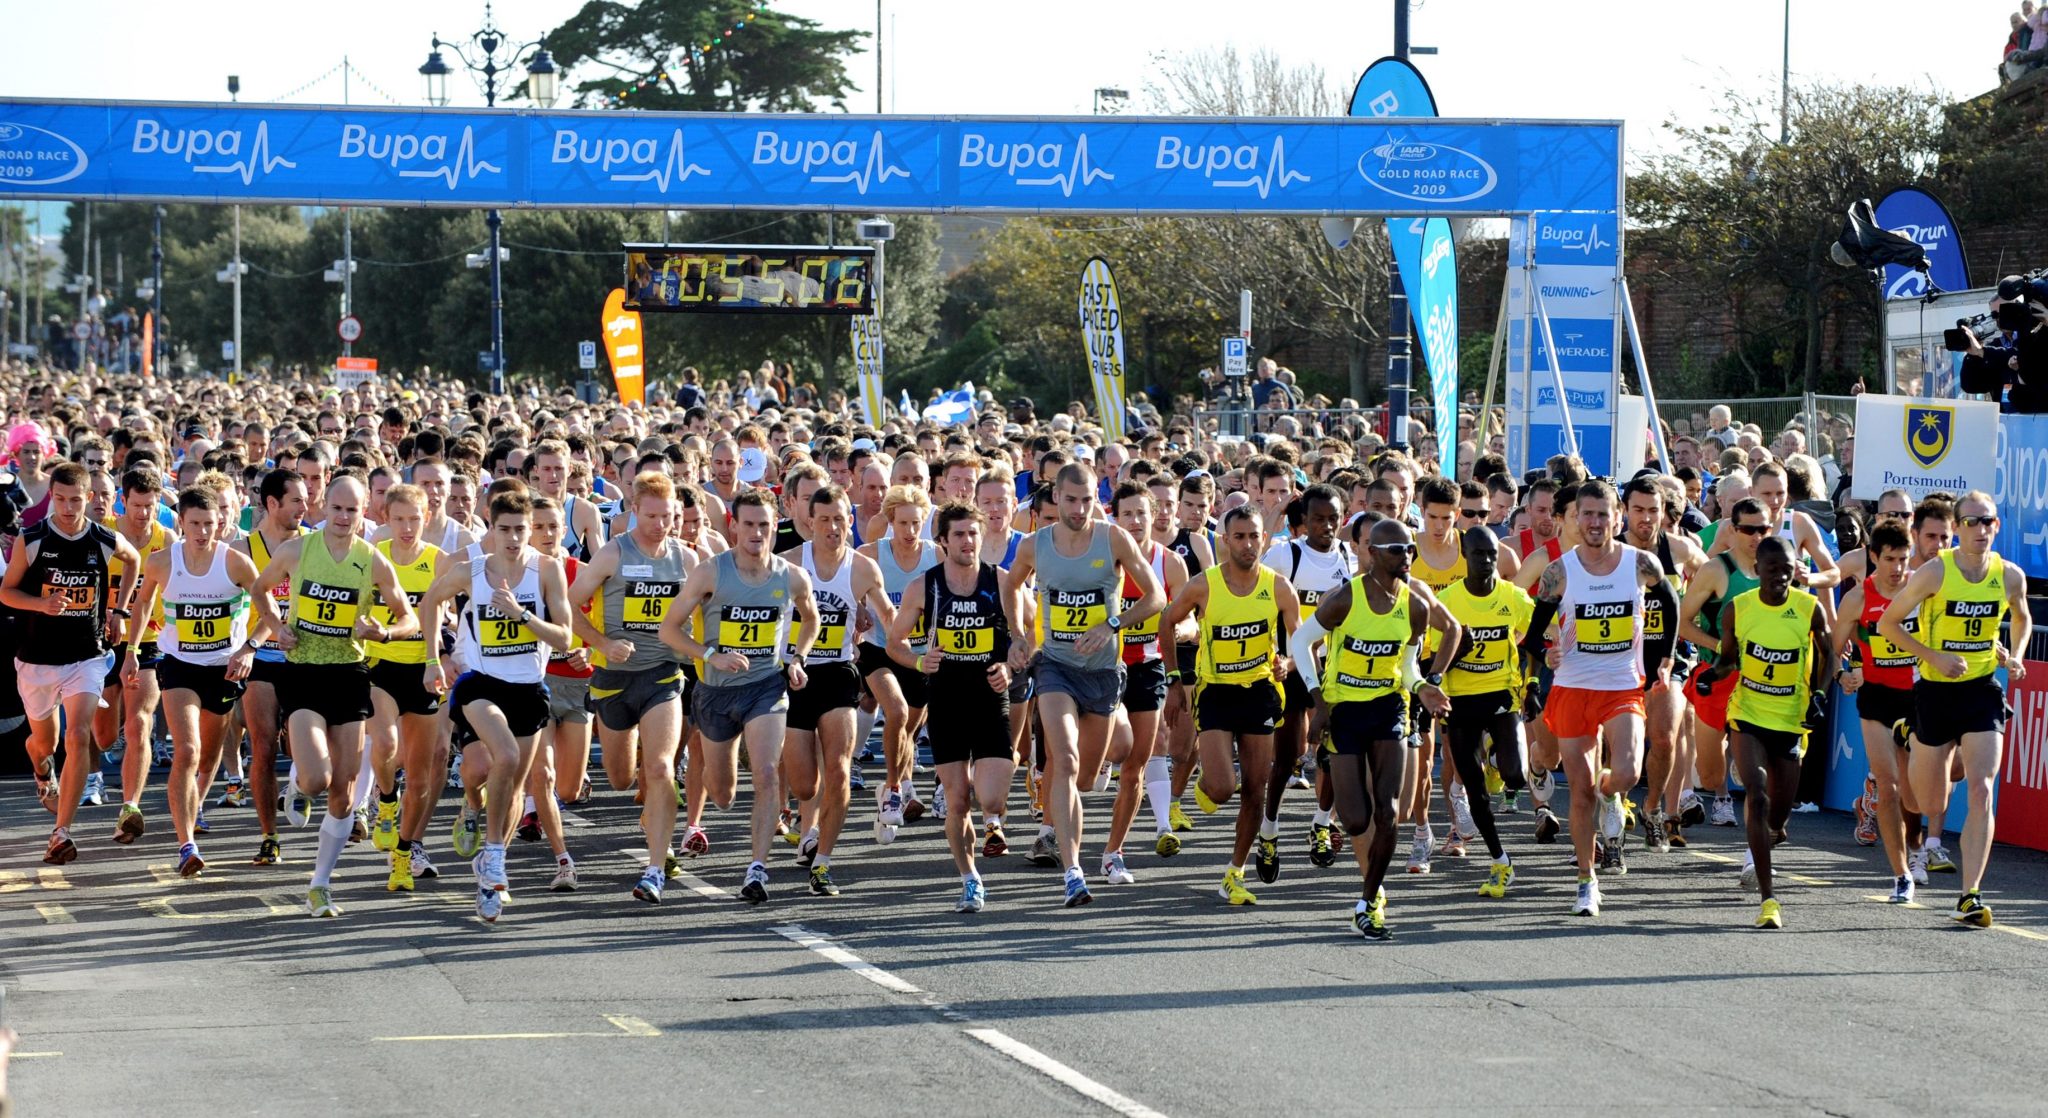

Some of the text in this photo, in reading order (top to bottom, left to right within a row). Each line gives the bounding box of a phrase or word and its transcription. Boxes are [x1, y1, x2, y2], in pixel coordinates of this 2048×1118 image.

[132, 119, 241, 163] Bupa
[339, 124, 447, 167] Bupa
[0, 150, 69, 161] ROAD RACE
[552, 129, 657, 172] Bupa
[752, 131, 857, 173] Bupa
[959, 133, 1063, 176] Bupa
[1155, 136, 1259, 178] Bupa
[0, 166, 34, 177] 2009
[1378, 169, 1480, 179] GOLD ROAD RACE
[1412, 184, 1447, 195] 2009
[1542, 226, 1584, 243] Bupa
[1919, 224, 1948, 242] run
[1083, 283, 1111, 306] FAST
[1541, 286, 1589, 298] RUNNING
[857, 341, 880, 361] CLU
[1091, 333, 1115, 358] UB
[1537, 347, 1609, 357] PWERADE
[1092, 359, 1121, 377] RERS
[1228, 358, 1242, 367] Pay
[1539, 389, 1604, 404] AQA-PURA
[1883, 470, 1967, 490] Portsmouth
[52, 572, 88, 587] Bupa
[1589, 584, 1615, 592] Reebok
[308, 582, 350, 602] Bupa
[634, 582, 672, 597] Bupa
[641, 599, 662, 617] 46
[951, 601, 977, 614] PARR
[1057, 591, 1096, 608] Bupa
[184, 604, 222, 620] Bupa
[316, 602, 336, 621] 13
[485, 604, 513, 619] Bu
[730, 606, 771, 622] Bupa
[1066, 608, 1088, 627] 22
[1584, 604, 1625, 619] Bupa
[1954, 601, 1993, 618] Bupa
[193, 620, 215, 638] 40
[298, 621, 348, 635] PORTSMOUTH
[495, 621, 519, 640] 20
[626, 623, 660, 631] PORTSMO
[944, 614, 985, 630] Bupa
[1599, 619, 1610, 638] 3
[1964, 618, 1982, 637] 19
[739, 623, 759, 642] 21
[953, 630, 977, 649] 30
[1053, 631, 1083, 641] PORTSM
[1124, 634, 1156, 643] TSMOUTH
[1220, 623, 1261, 640] Bupa
[181, 640, 228, 650] PORTSMOUTH
[483, 644, 535, 654] PORTSMOUTH
[722, 646, 772, 656] PORTSMOUTH
[790, 646, 838, 657] PSMOUTH
[1351, 638, 1393, 657] Bupa
[1475, 642, 1486, 659] 2
[1580, 643, 1631, 651] PORTSMOUTH
[1752, 643, 1792, 664] Bupa
[1944, 641, 1990, 651] PORTSMOUTH
[942, 653, 990, 662] PORTSMOUTH
[1219, 654, 1267, 672] PORTSMOUTH
[1875, 657, 1918, 667] PORTSMOUT
[1366, 658, 1375, 675] 1
[1763, 664, 1774, 681] 4
[1340, 674, 1392, 687] PORTSMOUTH
[1743, 678, 1792, 694] PORTSMOUTH
